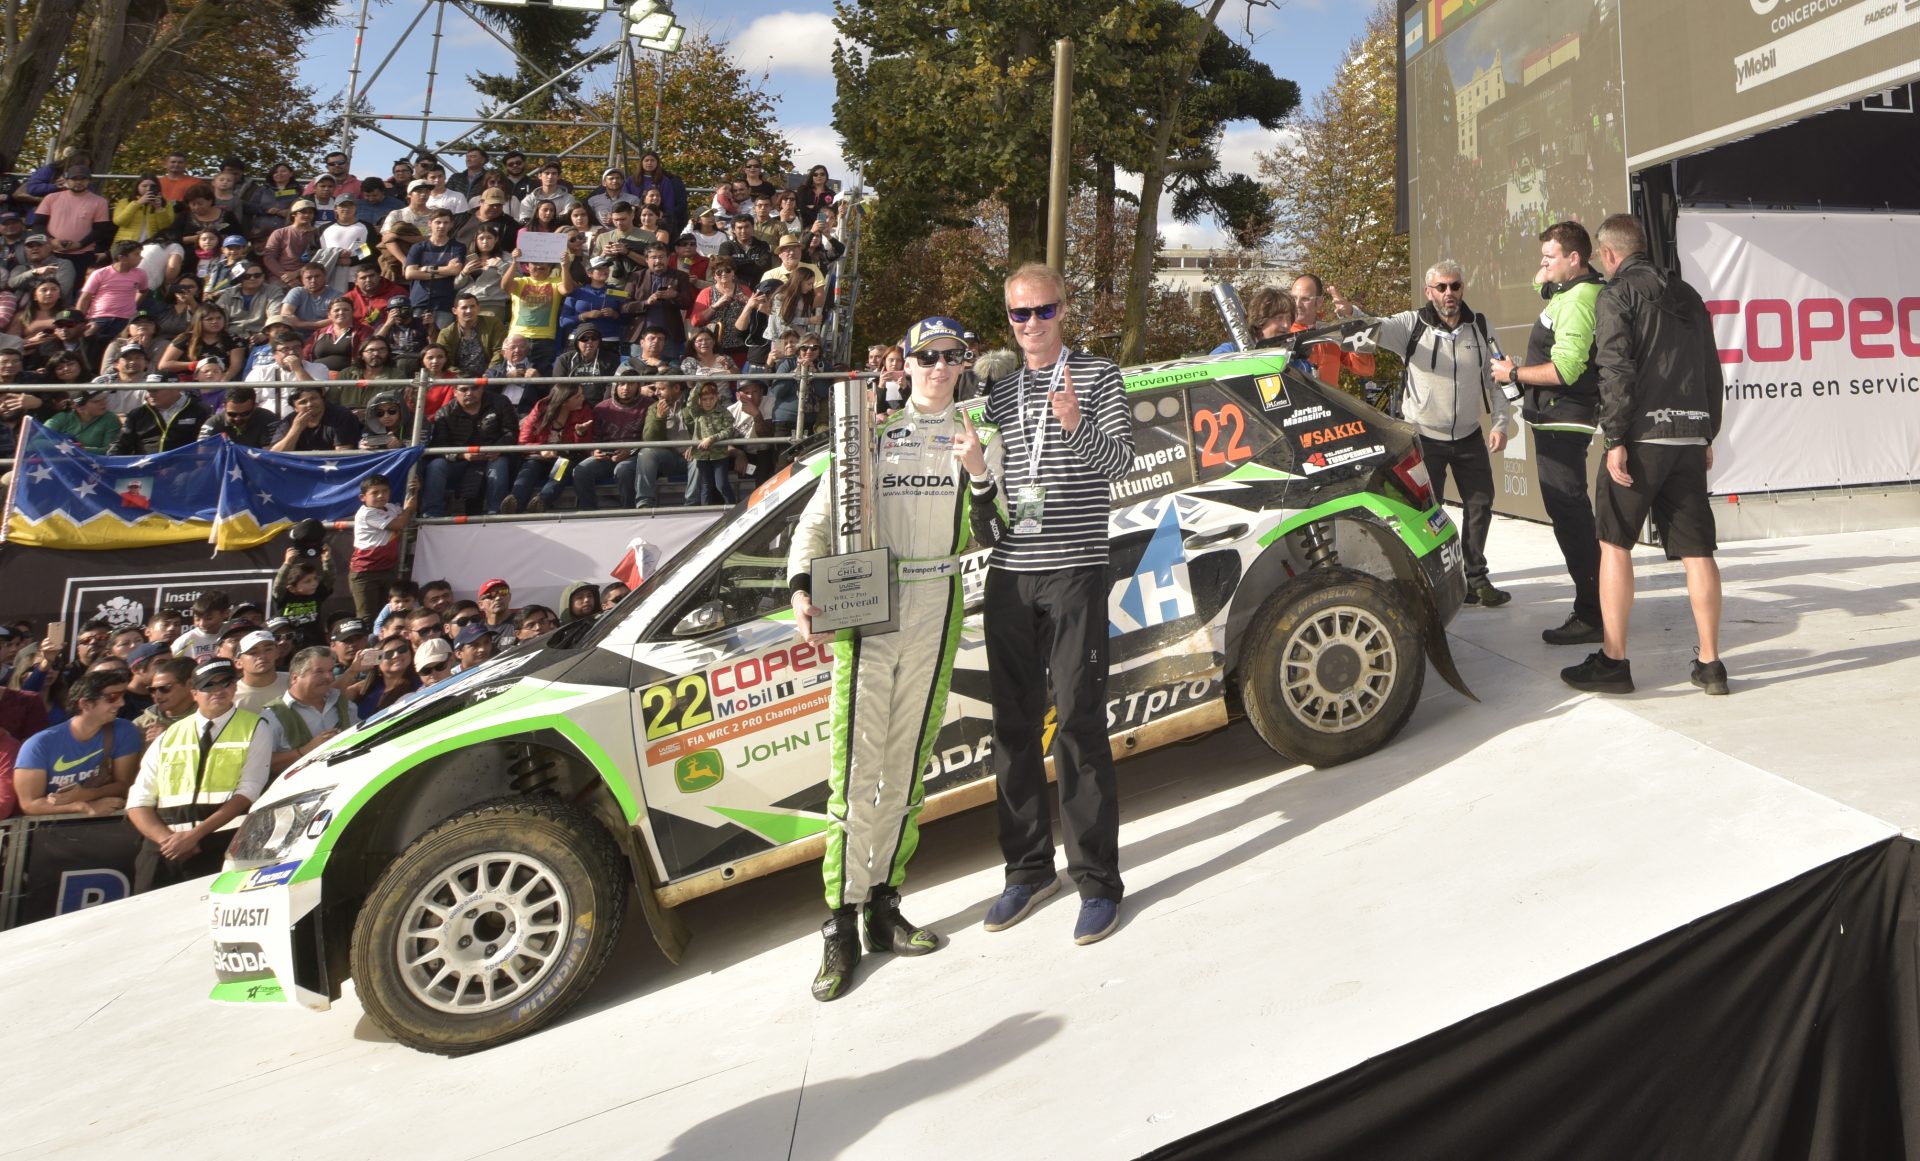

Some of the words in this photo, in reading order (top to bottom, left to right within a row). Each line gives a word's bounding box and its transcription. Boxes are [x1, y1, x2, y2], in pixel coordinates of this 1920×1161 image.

[1864, 2, 1898, 26] FADECH
[1725, 379, 1803, 401] rimera
[1812, 380, 1840, 397] en
[1850, 372, 1920, 395] servic
[1193, 403, 1252, 468] 22
[1312, 420, 1366, 445] SAKKI
[1130, 443, 1187, 473] nperä
[882, 474, 955, 489] ŠKODA
[1109, 471, 1174, 502] lttunen
[165, 591, 203, 603] Instit
[823, 603, 838, 613] 1st
[840, 595, 879, 610] Overall
[642, 674, 713, 741] 22
[717, 687, 773, 719] Mobil
[687, 734, 706, 748] FIA
[706, 725, 730, 742] WRC
[732, 723, 740, 733] 2
[742, 715, 763, 731] PRO
[736, 730, 811, 768] JOHN
[49, 773, 77, 785] JUST
